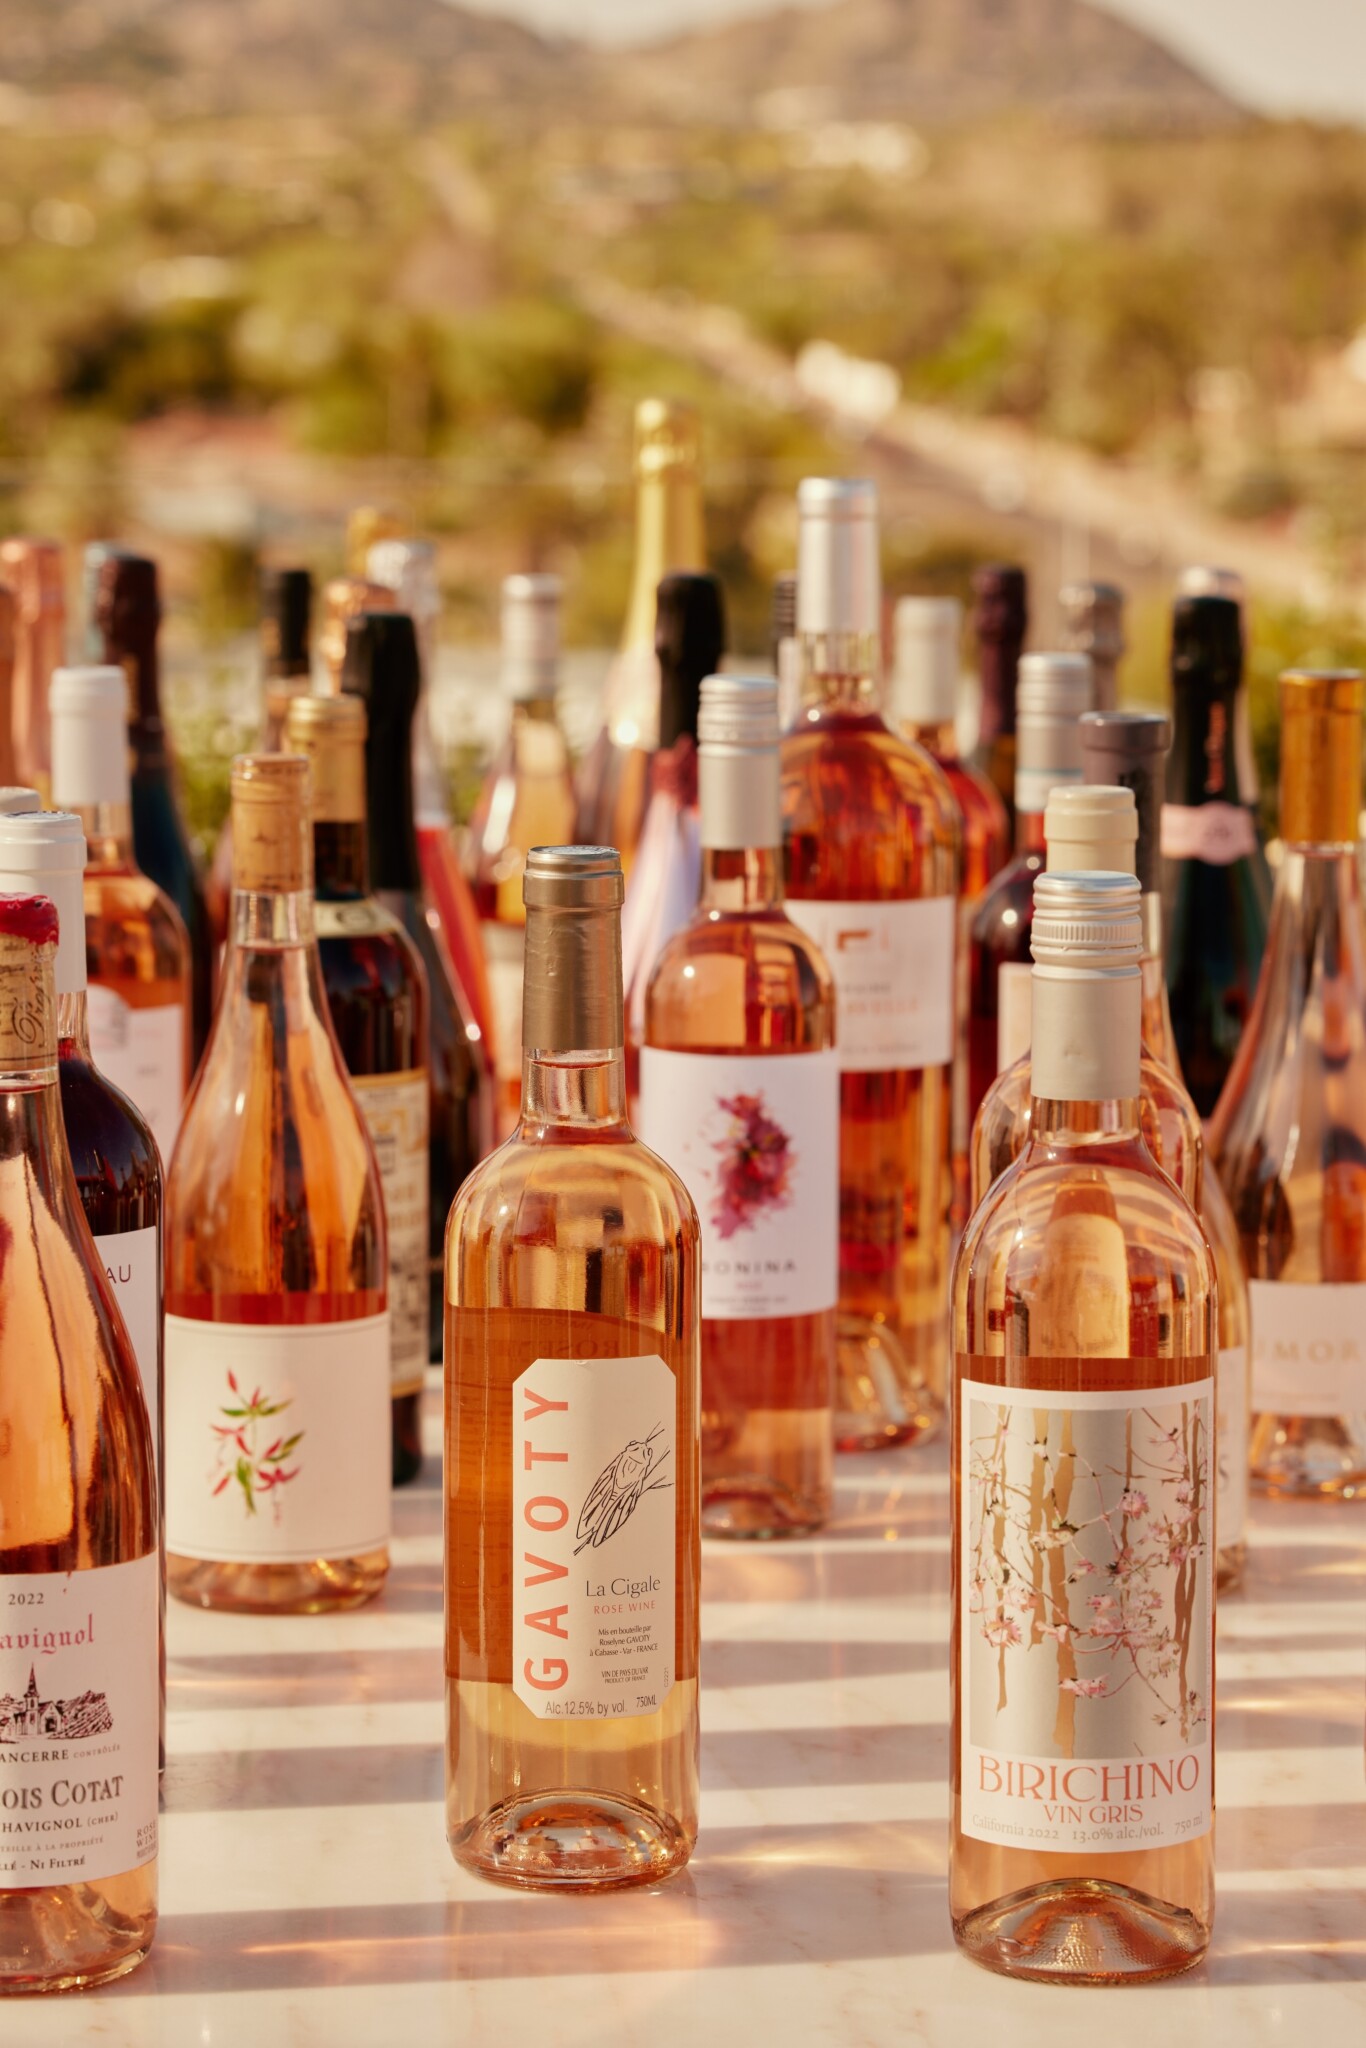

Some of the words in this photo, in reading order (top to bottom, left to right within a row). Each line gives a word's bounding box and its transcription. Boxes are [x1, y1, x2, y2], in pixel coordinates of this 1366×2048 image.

[523, 1387, 569, 1692] GAVOTY
[586, 1579, 606, 1597] La
[611, 1574, 661, 1599] Cigale
[8, 1592, 45, 1606] 2022
[593, 1603, 624, 1615] ROSE
[628, 1600, 656, 1612] WINE
[598, 1628, 610, 1636] Mis
[618, 1625, 643, 1634] bouteille
[643, 1625, 652, 1634] par
[599, 1638, 626, 1648] Roselyne
[626, 1634, 651, 1645] GAVOTY
[594, 1648, 619, 1657] Cabasse
[622, 1647, 632, 1655] Var
[636, 1643, 659, 1653] FRANCE
[601, 1670, 611, 1678] VIN
[611, 1669, 619, 1678] DE
[619, 1668, 632, 1677] PAYS
[631, 1667, 639, 1676] DU
[638, 1666, 649, 1675] VAR
[631, 1674, 646, 1682] FRANCE
[597, 1700, 609, 1717] by
[611, 1698, 628, 1713] vol.
[636, 1694, 657, 1709] 750ML
[979, 1754, 1200, 1803] BIRICHINO
[2, 1786, 44, 1810] OIS
[51, 1775, 124, 1808] COTAT
[2, 1817, 83, 1833] HAVIGNOL
[87, 1811, 119, 1827] (CHER)
[1043, 1804, 1083, 1824] VIN
[1088, 1803, 1144, 1824] GRIS
[972, 1813, 1025, 1837] California
[1028, 1827, 1060, 1841] 2022
[1072, 1827, 1114, 1845] 13.0%
[1115, 1821, 1165, 1842] alc./vol.
[1174, 1819, 1193, 1837] 750
[1192, 1811, 1204, 1829] ml
